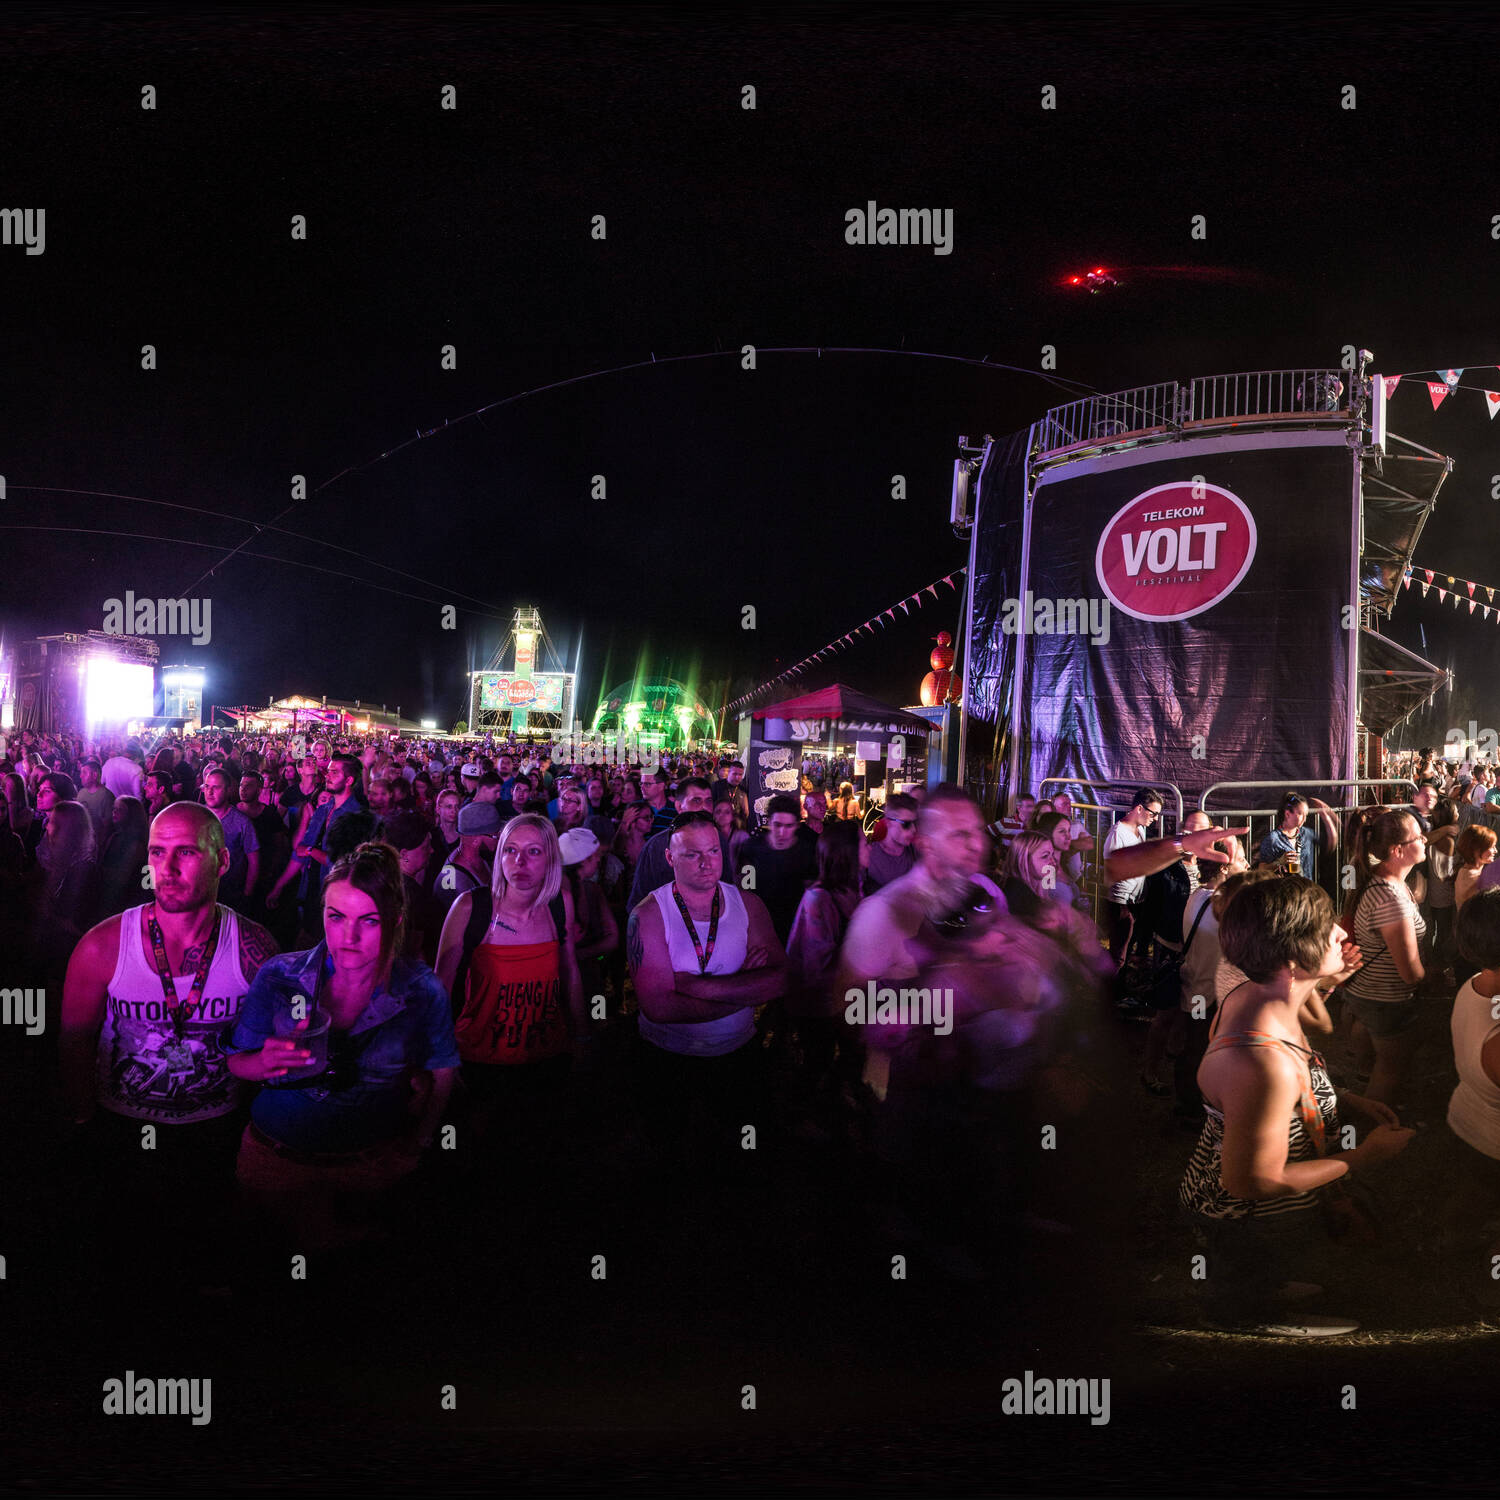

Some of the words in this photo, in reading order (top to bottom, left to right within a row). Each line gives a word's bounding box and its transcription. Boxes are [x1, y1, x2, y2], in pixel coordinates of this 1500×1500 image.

[1430, 386, 1448, 394] VOLT
[1142, 506, 1205, 522] TELEKOM
[1121, 522, 1227, 577] VOLT
[109, 995, 247, 1021] MOTOYCLE
